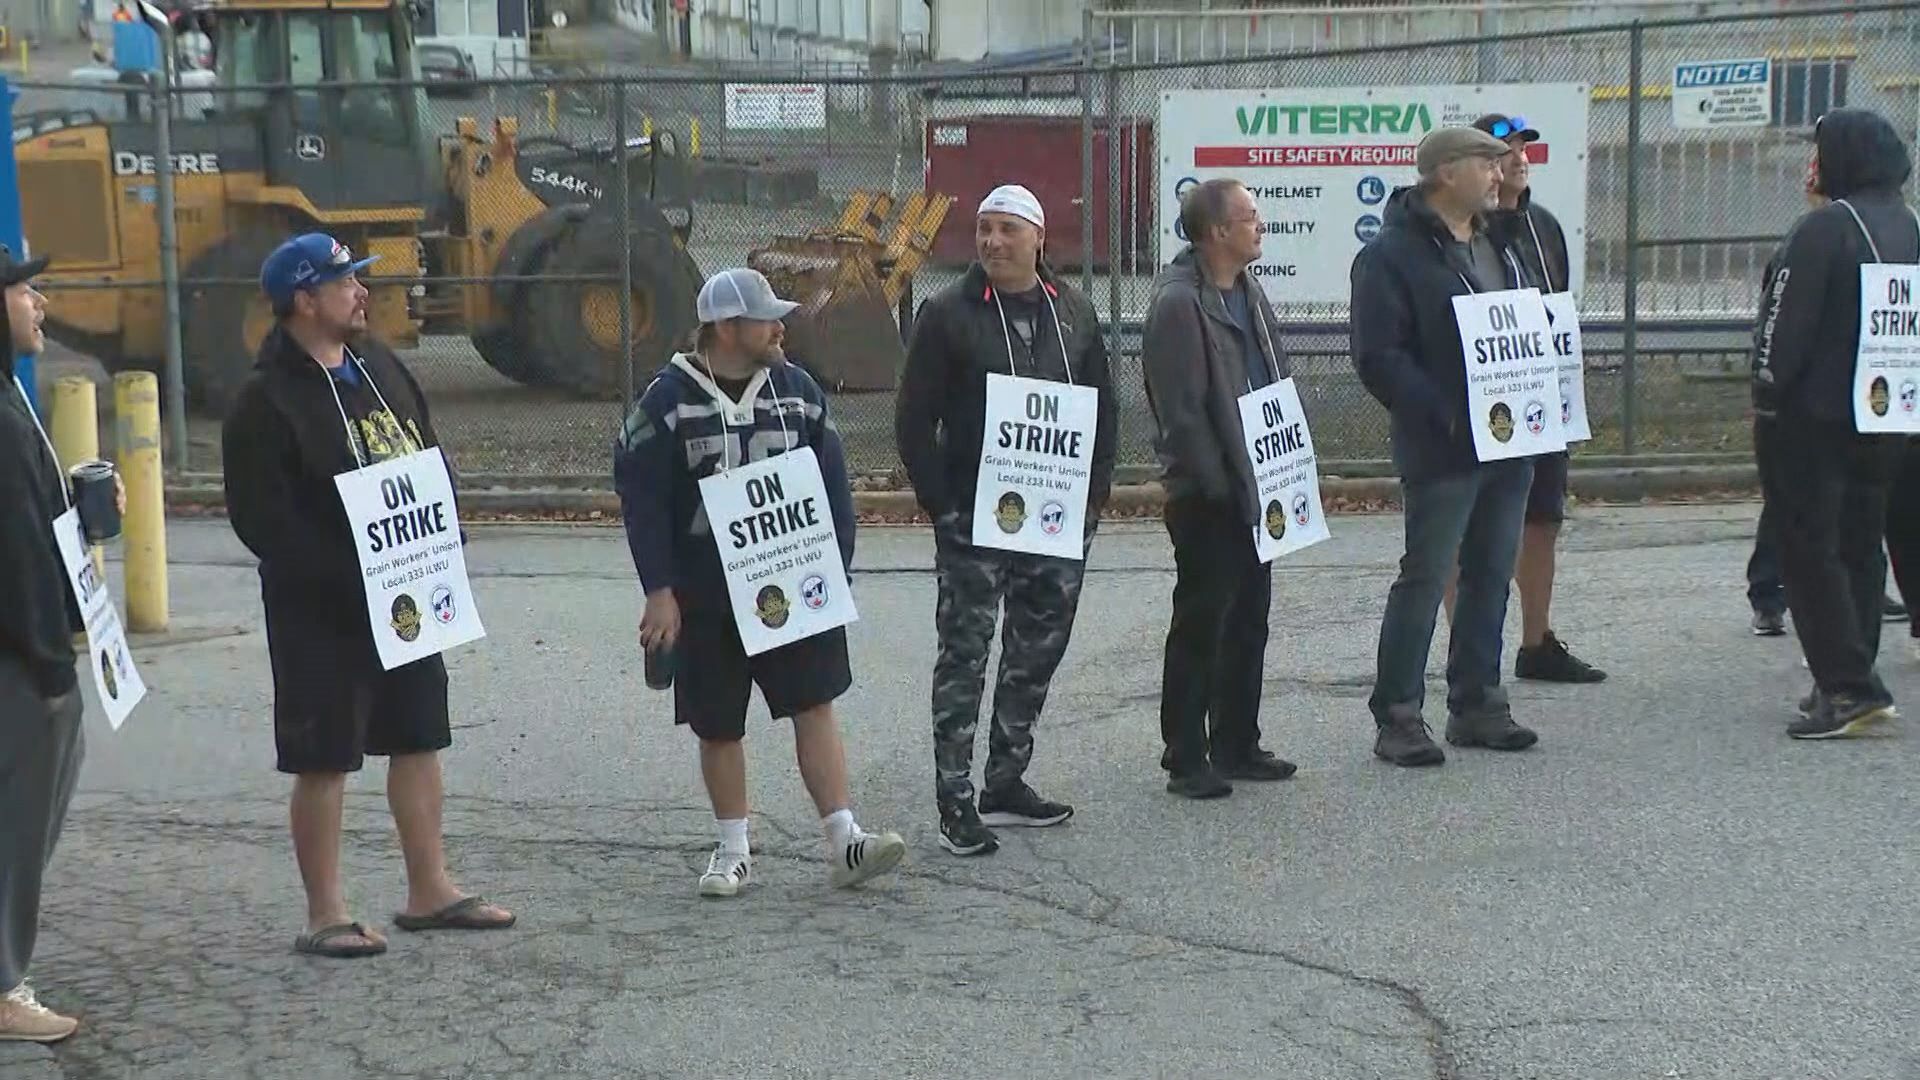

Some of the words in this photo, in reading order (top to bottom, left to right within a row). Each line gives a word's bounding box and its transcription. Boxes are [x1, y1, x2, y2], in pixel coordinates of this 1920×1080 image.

[1680, 62, 1763, 85] NOTICE
[1236, 103, 1432, 135] VITERRA
[1248, 148, 1286, 163] SITE
[1287, 148, 1350, 163] SAFETY
[1265, 187, 1322, 198] HELMET
[1888, 278, 1911, 305] ON
[1489, 303, 1518, 332] ON
[1870, 309, 1920, 336] STRIK
[1474, 331, 1545, 364] STRIKE
[1530, 365, 1556, 376] Union
[1483, 386, 1506, 396] Local
[1025, 393, 1059, 422] ON
[1262, 397, 1285, 428] ON
[998, 421, 1082, 458] STRIKE
[1254, 423, 1305, 464] STRIKE
[985, 455, 1012, 467] Grain
[1058, 465, 1087, 478] Union
[381, 473, 416, 510] ON
[746, 472, 785, 508] ON
[997, 472, 1024, 485] Local
[1046, 480, 1072, 491] ILWU
[367, 501, 447, 553] STRIKE
[728, 497, 820, 549] STRIKE
[366, 562, 391, 578] Grain
[431, 540, 459, 556] Union
[727, 556, 755, 572] Grain
[802, 531, 833, 547] Union
[382, 574, 407, 590] Local
[746, 566, 774, 582] Local
